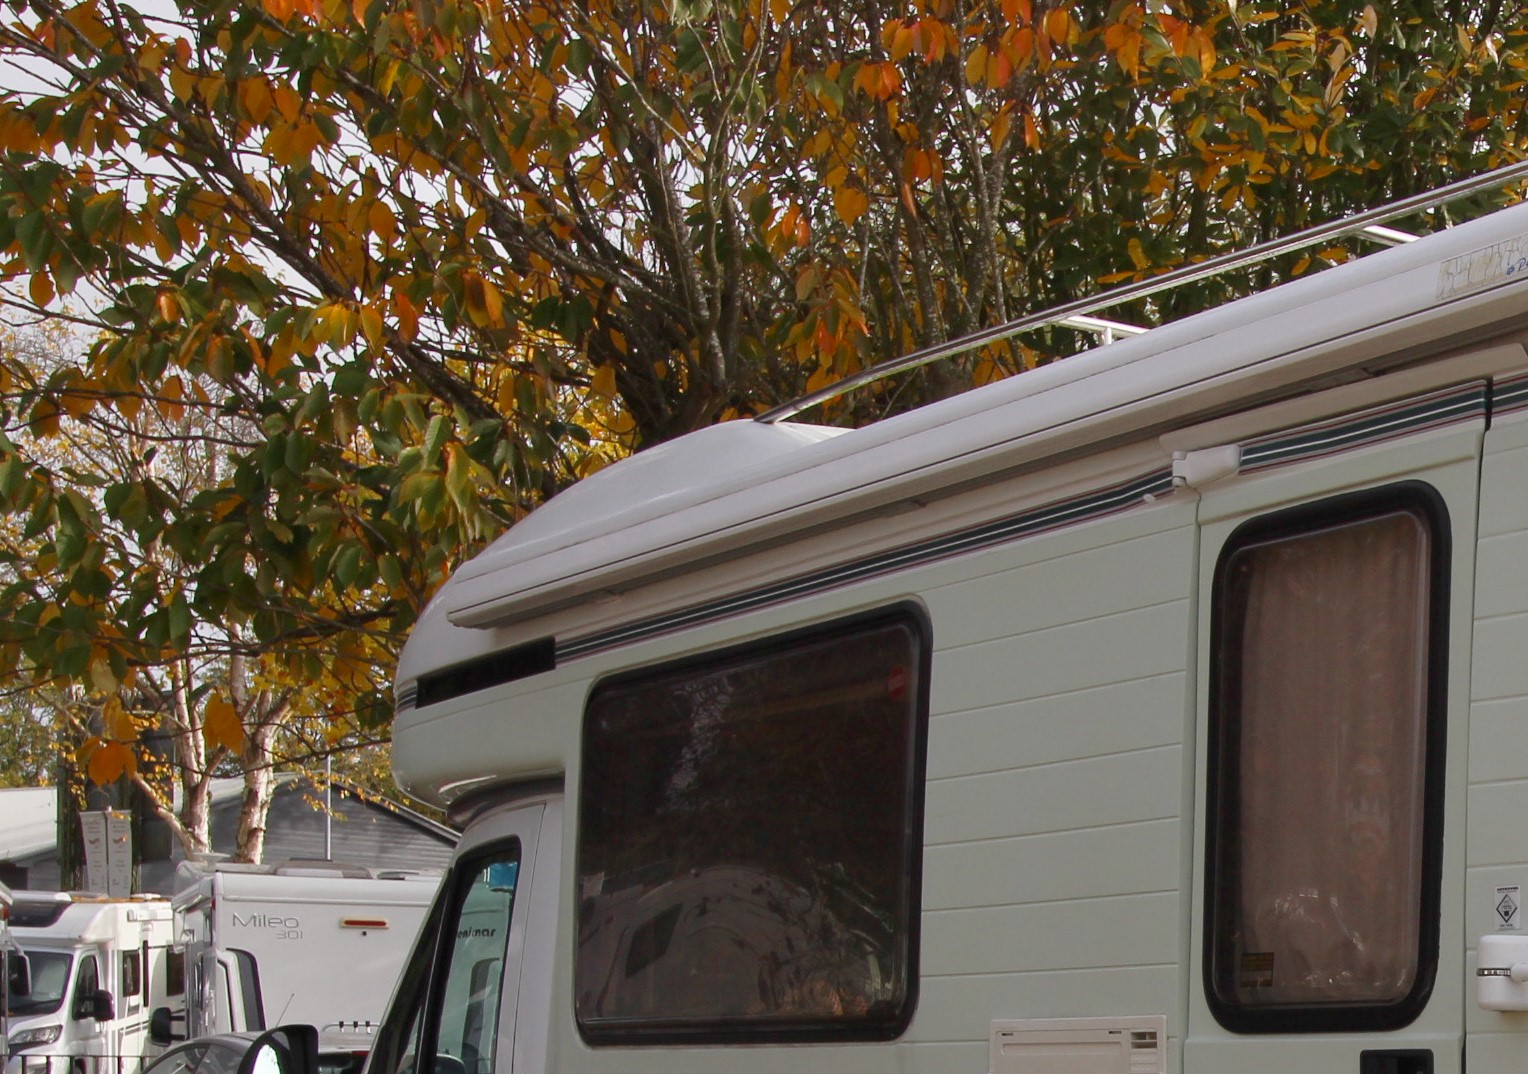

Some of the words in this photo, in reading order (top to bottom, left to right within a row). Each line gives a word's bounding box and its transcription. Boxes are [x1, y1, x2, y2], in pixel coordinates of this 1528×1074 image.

[232, 912, 299, 929] Mileo
[276, 930, 303, 940] 301
[457, 926, 496, 939] enimar
